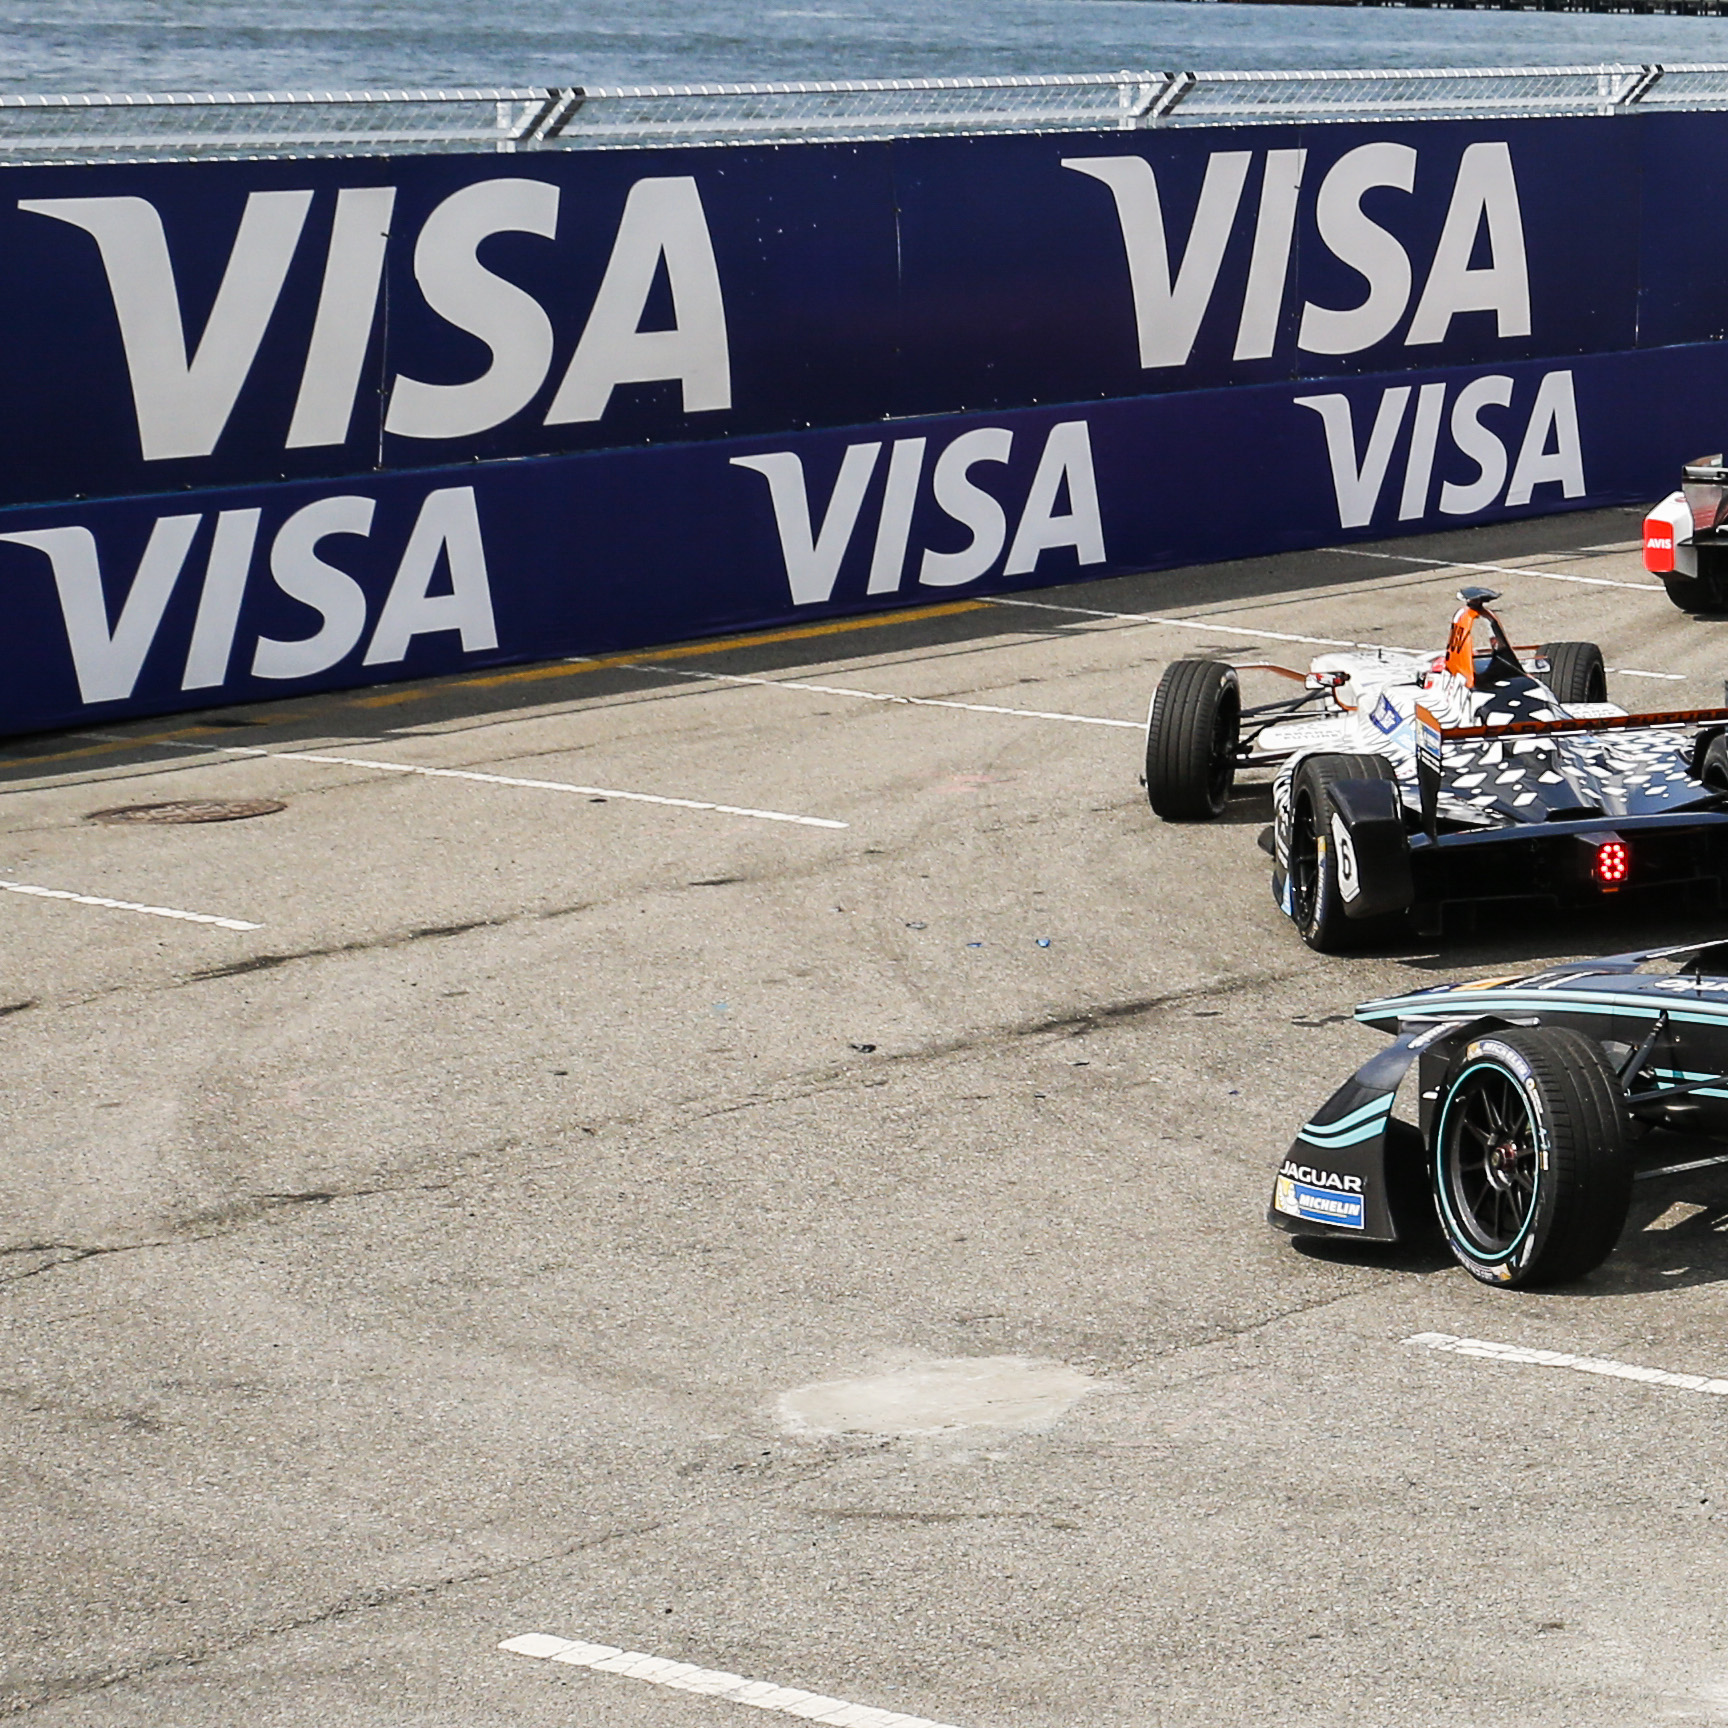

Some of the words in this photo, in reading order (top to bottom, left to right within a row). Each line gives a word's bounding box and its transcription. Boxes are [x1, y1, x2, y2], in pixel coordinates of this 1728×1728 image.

[17, 176, 732, 462] VISA
[1061, 141, 1531, 369] VISA
[729, 420, 1107, 605] VISA
[1294, 370, 1586, 529] VISA
[0, 486, 498, 705] VISA
[1647, 538, 1672, 550] AVIS
[1342, 838, 1352, 881] 6
[1279, 1160, 1363, 1192] JAGUAR
[1299, 1191, 1361, 1216] MICHELIN
